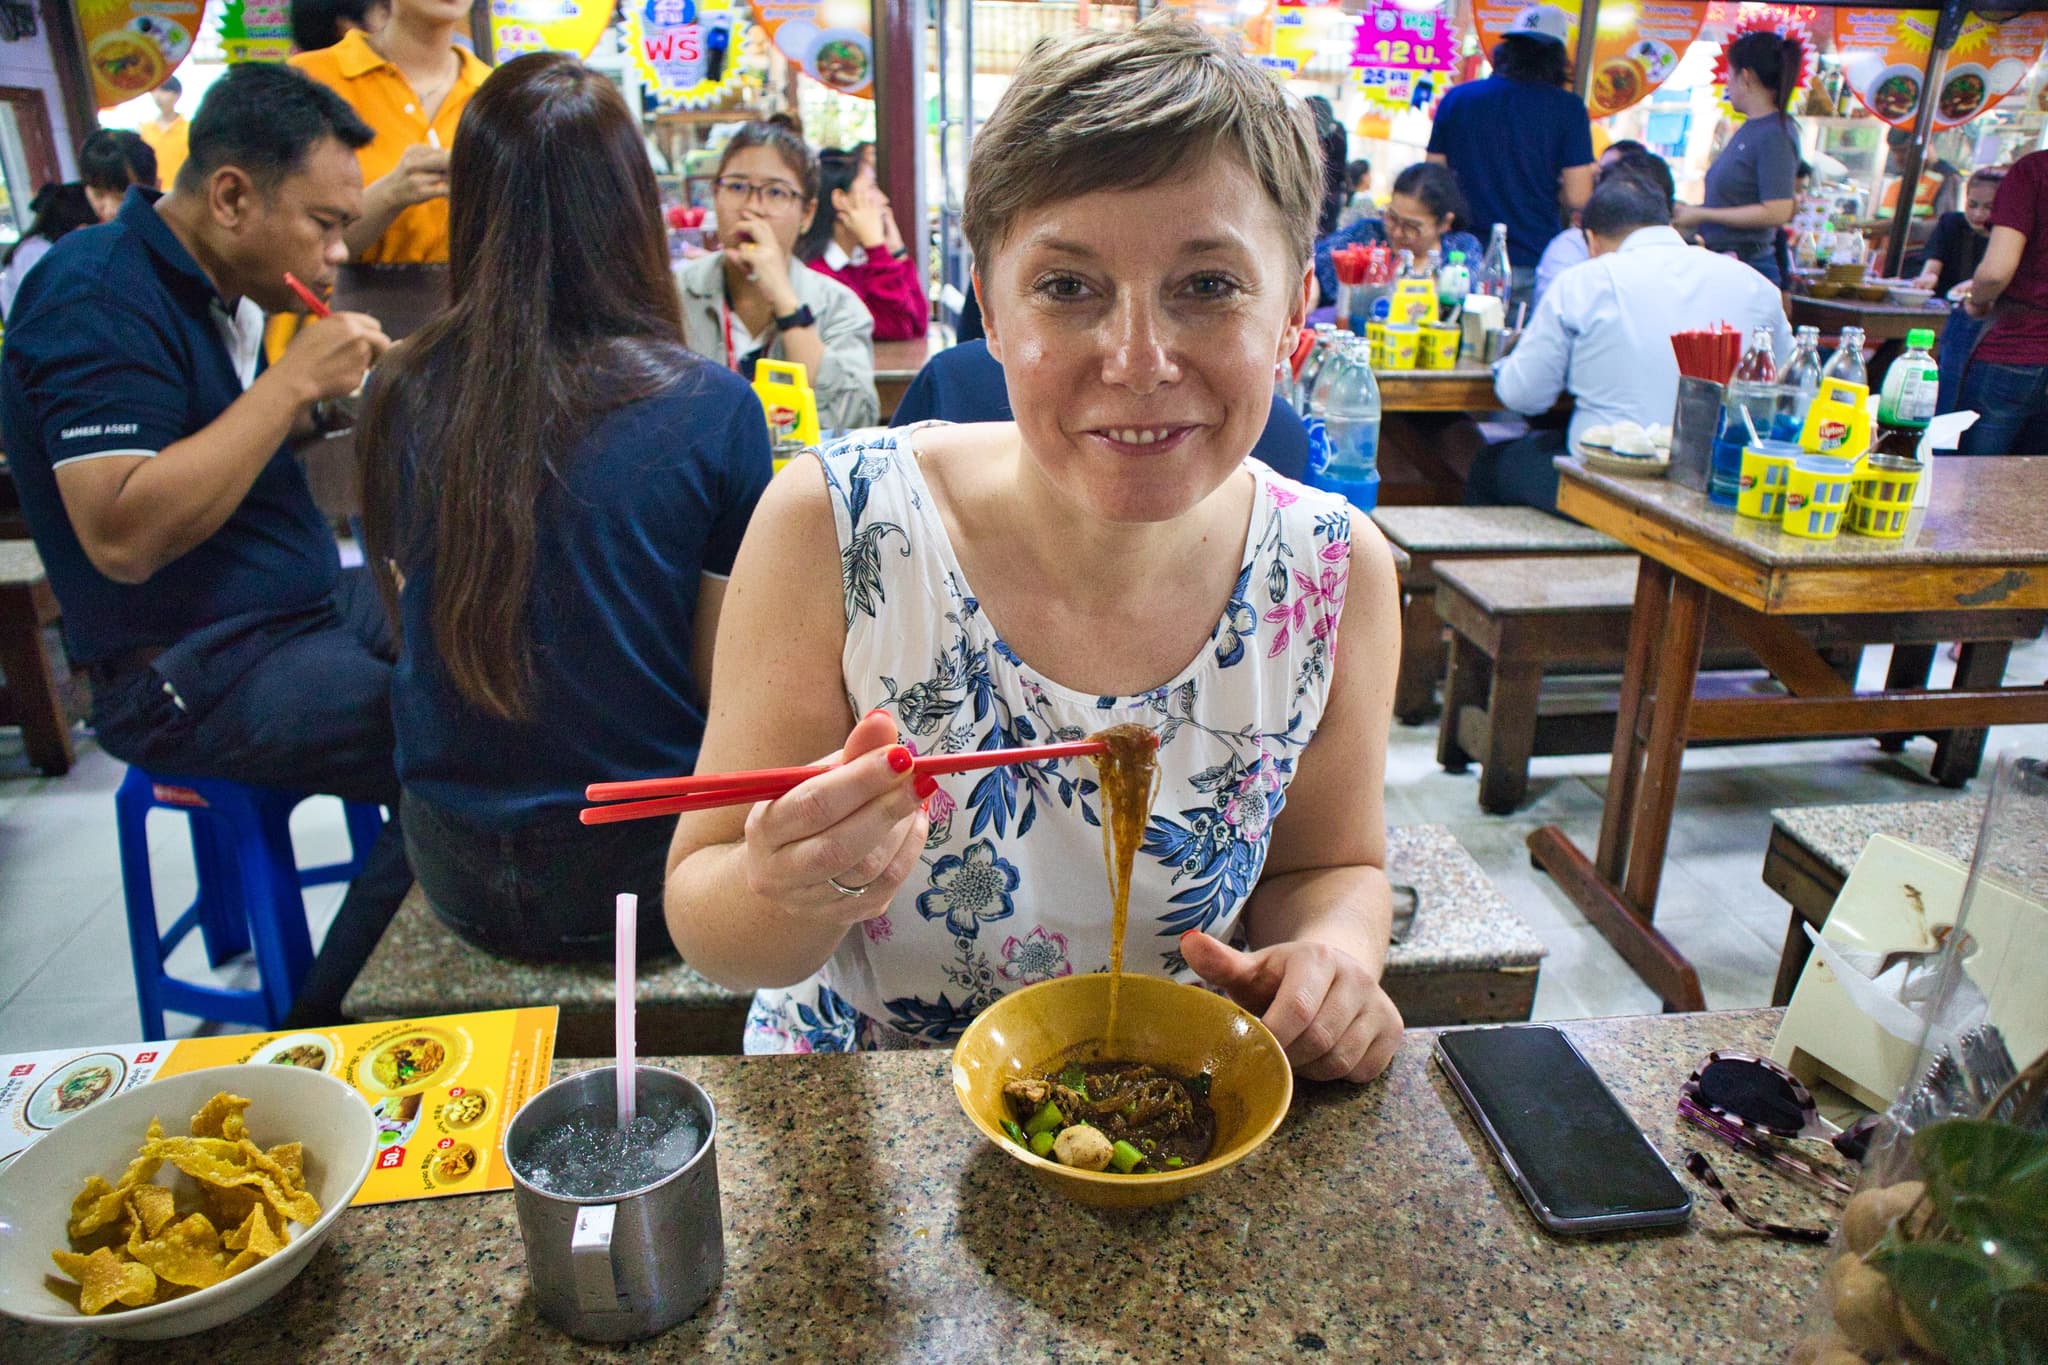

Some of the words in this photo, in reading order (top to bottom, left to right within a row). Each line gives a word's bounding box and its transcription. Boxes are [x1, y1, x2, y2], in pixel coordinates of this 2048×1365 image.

[1375, 40, 1409, 63] 12
[1364, 69, 1385, 84] 25
[104, 423, 138, 434] ASSET
[1820, 425, 1846, 438] Lipton
